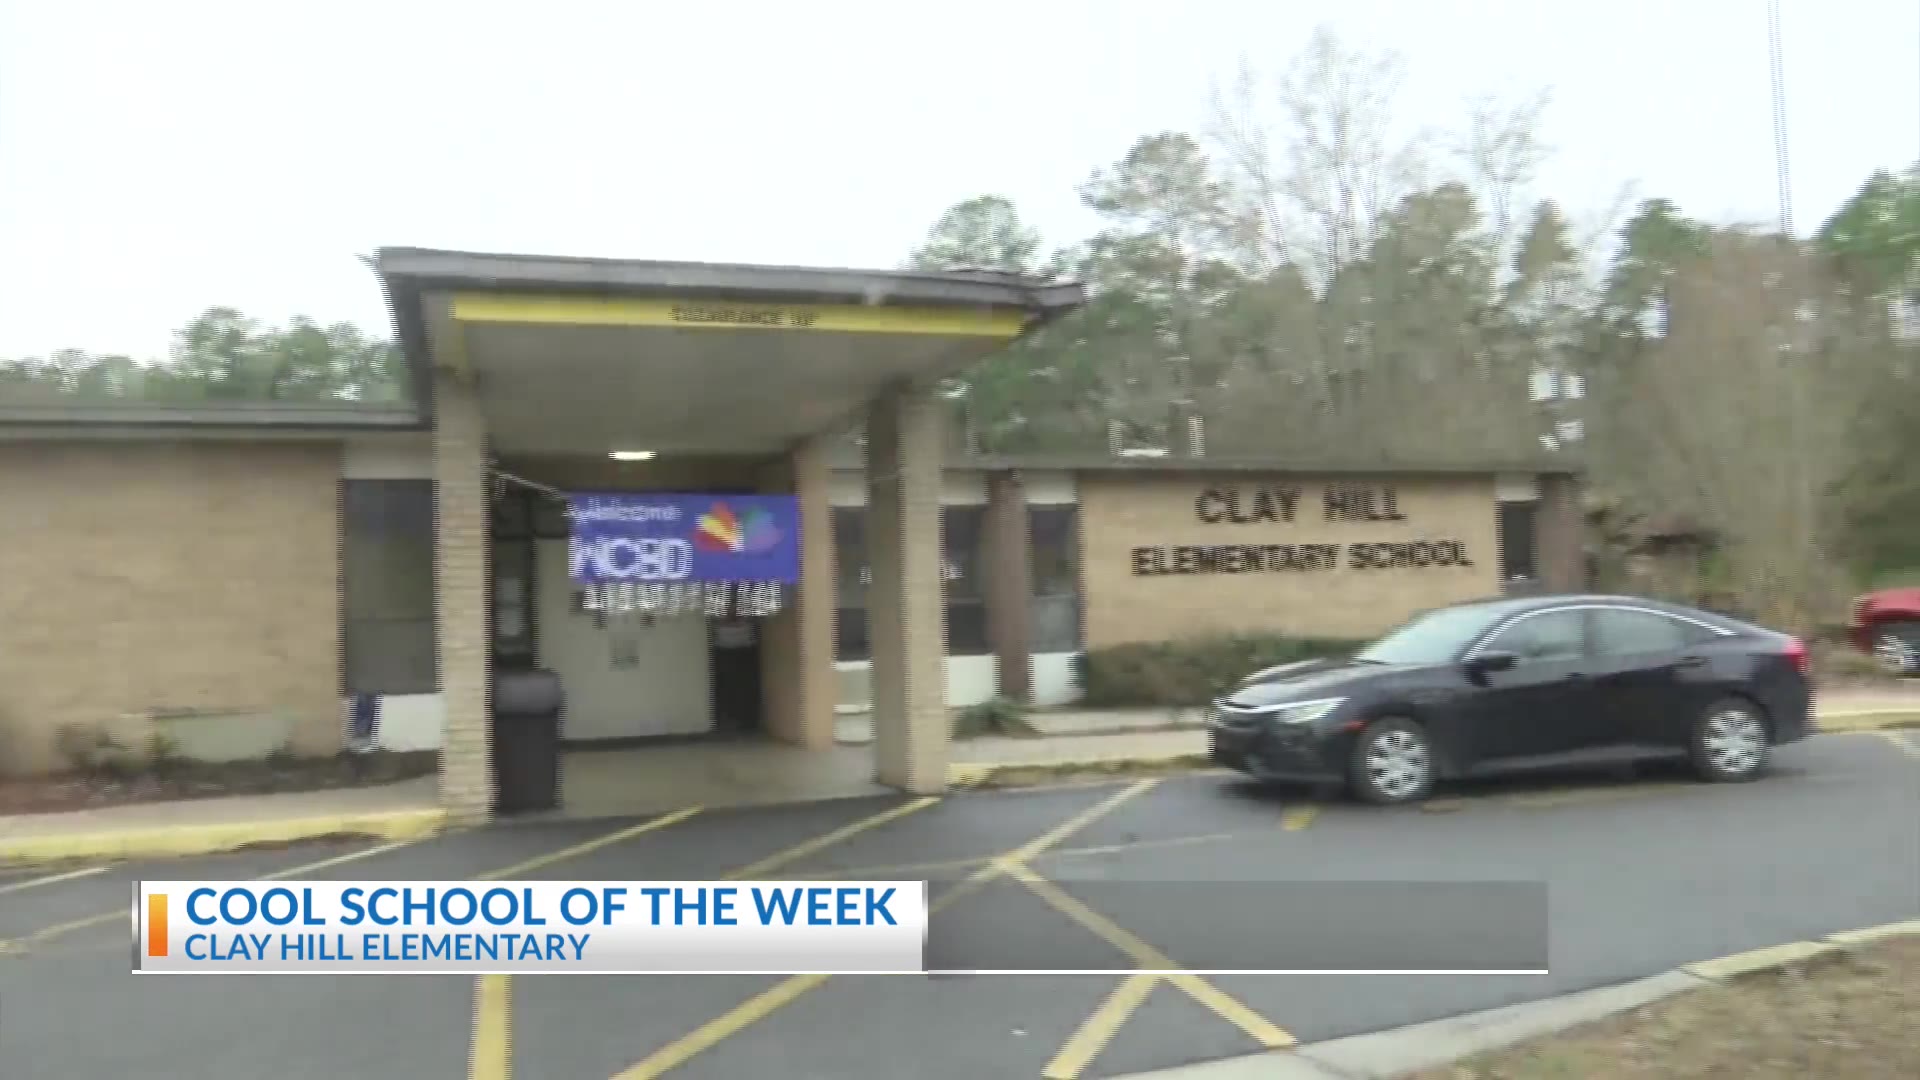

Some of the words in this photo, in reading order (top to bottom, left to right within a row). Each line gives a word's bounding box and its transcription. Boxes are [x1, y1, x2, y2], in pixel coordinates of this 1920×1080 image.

[564, 497, 681, 524] Welcome
[1195, 485, 1301, 524] CLAY
[1322, 484, 1408, 523] HILL
[568, 535, 693, 579] WCBD
[1132, 544, 1341, 576] ELEMENTARY
[1348, 540, 1474, 570] SCHOOL
